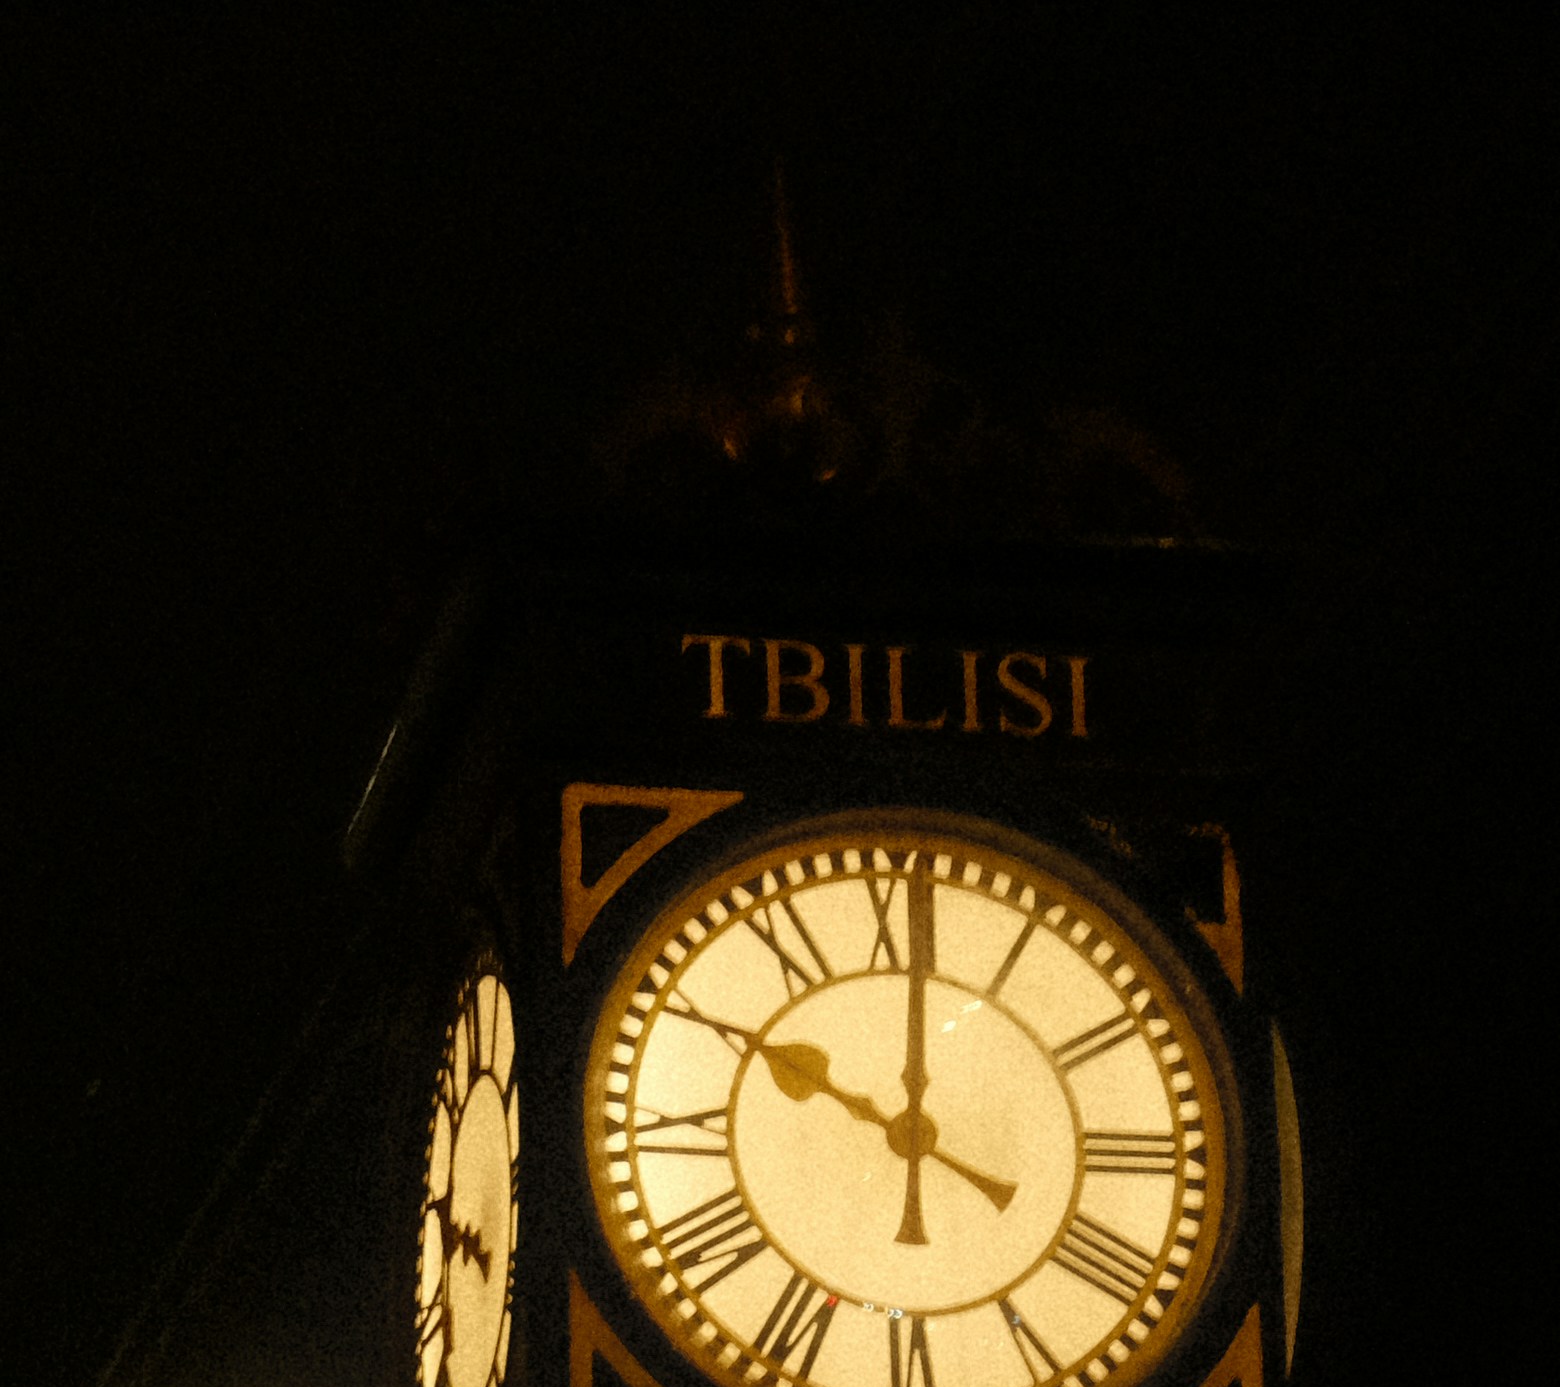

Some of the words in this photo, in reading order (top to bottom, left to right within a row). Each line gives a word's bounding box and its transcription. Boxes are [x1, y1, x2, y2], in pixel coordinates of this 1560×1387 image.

[681, 634, 1088, 738] TBILISI
[1052, 1010, 1143, 1071] II
[632, 1105, 731, 1158] IX
[1083, 1131, 1177, 1175] III
[655, 1189, 773, 1296] VIII
[1049, 1213, 1159, 1306] IIII
[751, 1270, 837, 1382] VII
[997, 1297, 1065, 1382] V
